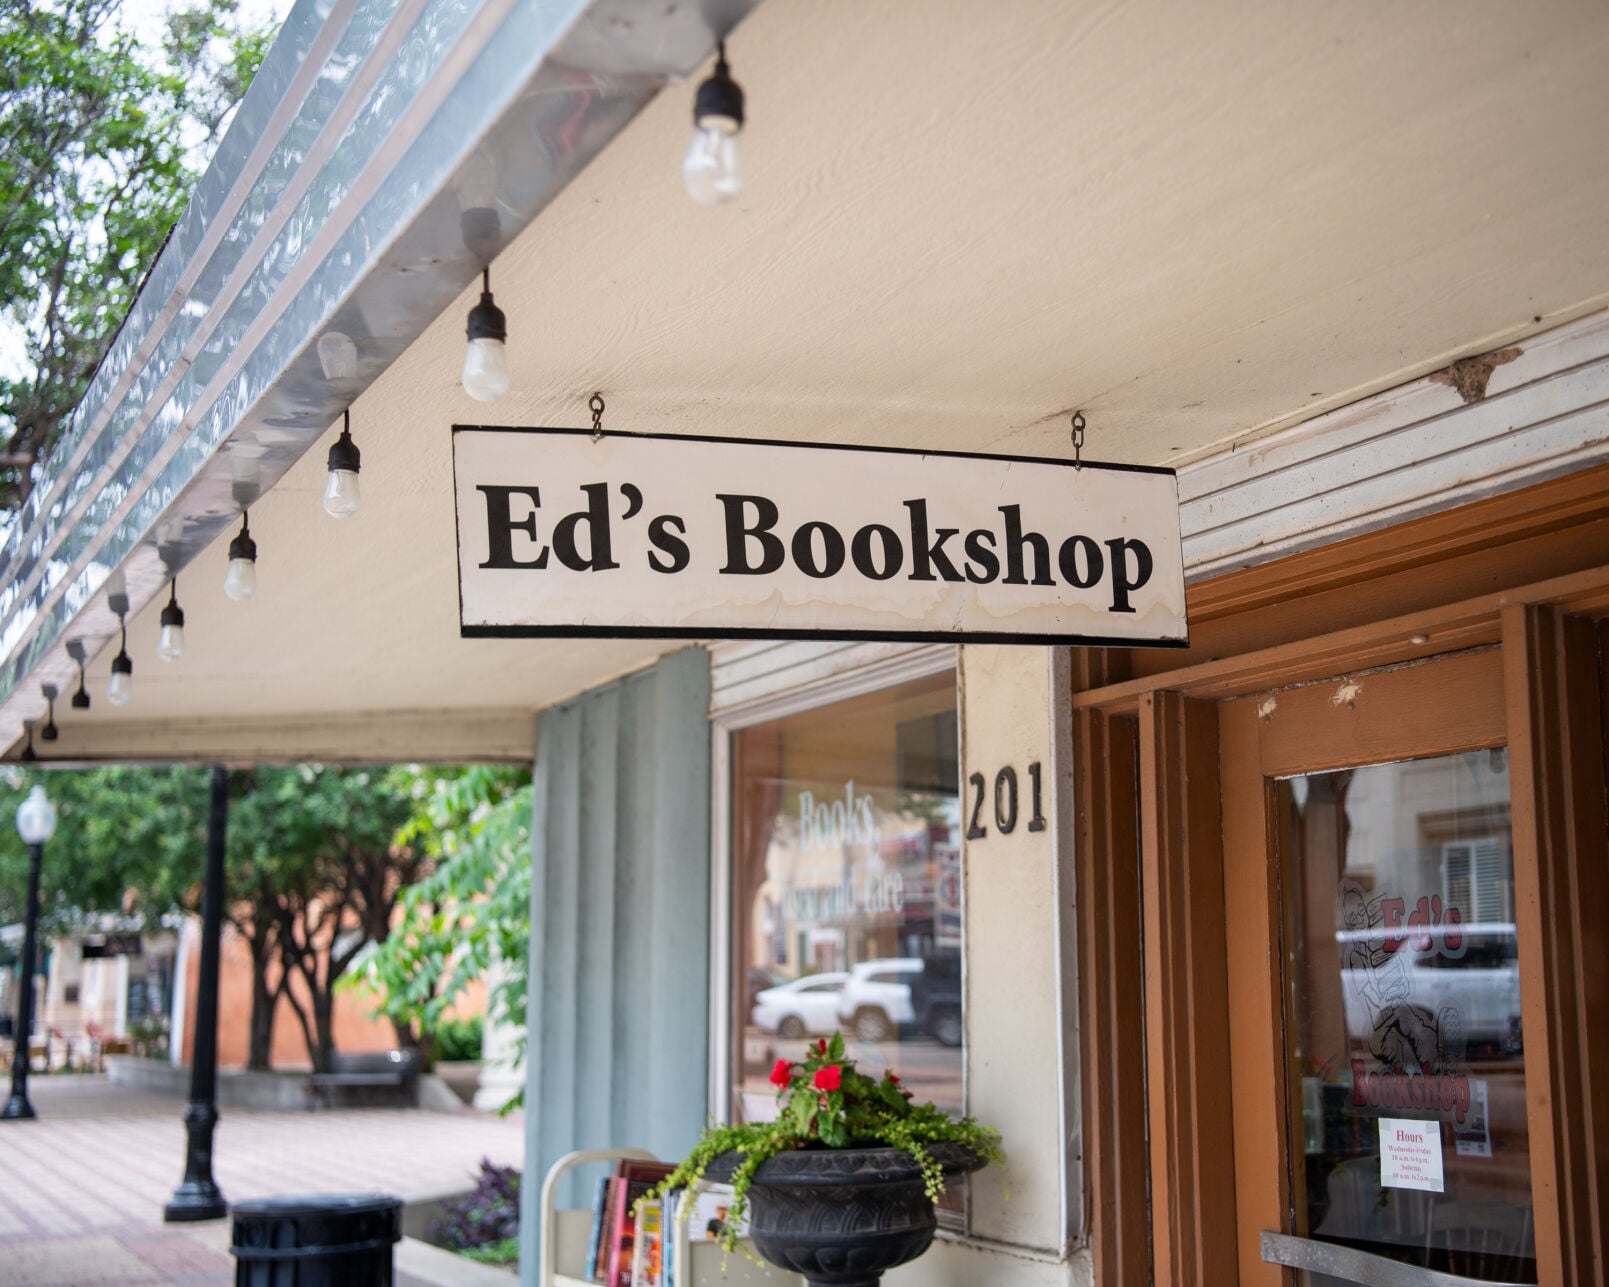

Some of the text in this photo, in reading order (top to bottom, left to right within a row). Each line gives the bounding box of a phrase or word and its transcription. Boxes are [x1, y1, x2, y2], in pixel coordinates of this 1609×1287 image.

[476, 482, 1153, 613] Ed's Bookshop
[966, 761, 1047, 840] 201
[1382, 894, 1462, 953] Ed's
[1352, 1059, 1470, 1124] Bookshop
[1396, 1130, 1424, 1143] Hours
